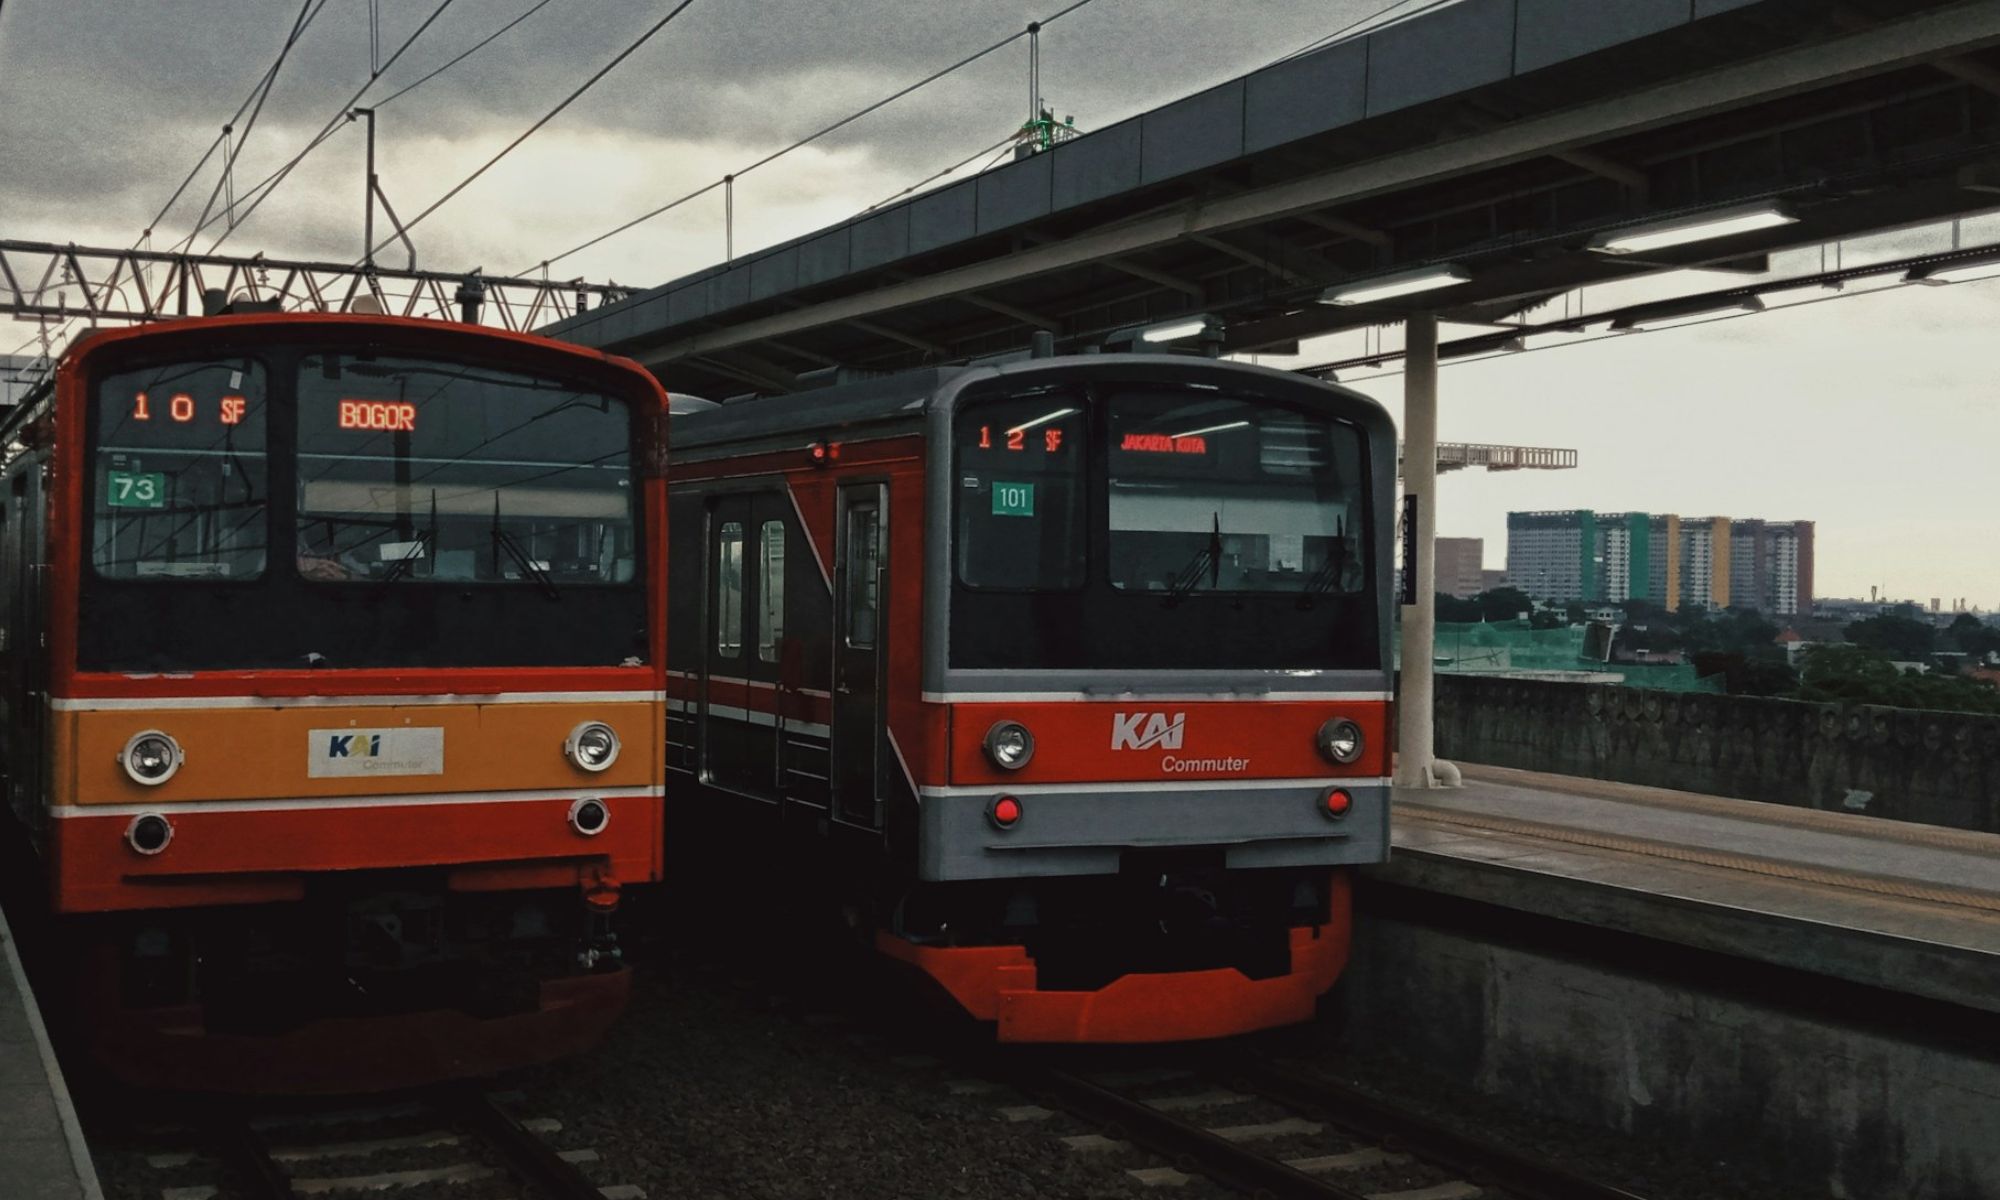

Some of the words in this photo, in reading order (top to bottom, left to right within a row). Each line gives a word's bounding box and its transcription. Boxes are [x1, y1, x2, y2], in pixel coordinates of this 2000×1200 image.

[220, 398, 246, 424] SF
[339, 402, 416, 431] BOGOR
[1045, 430, 1062, 451] SF
[1121, 433, 1174, 452] JAKARTA
[1175, 436, 1206, 454] KOTA
[114, 478, 156, 500] 73
[1000, 488, 1026, 508] 101
[1111, 712, 1186, 750] KAI
[329, 735, 380, 758] KAI
[363, 759, 424, 770] Commuter
[1162, 755, 1249, 773] Commuter
